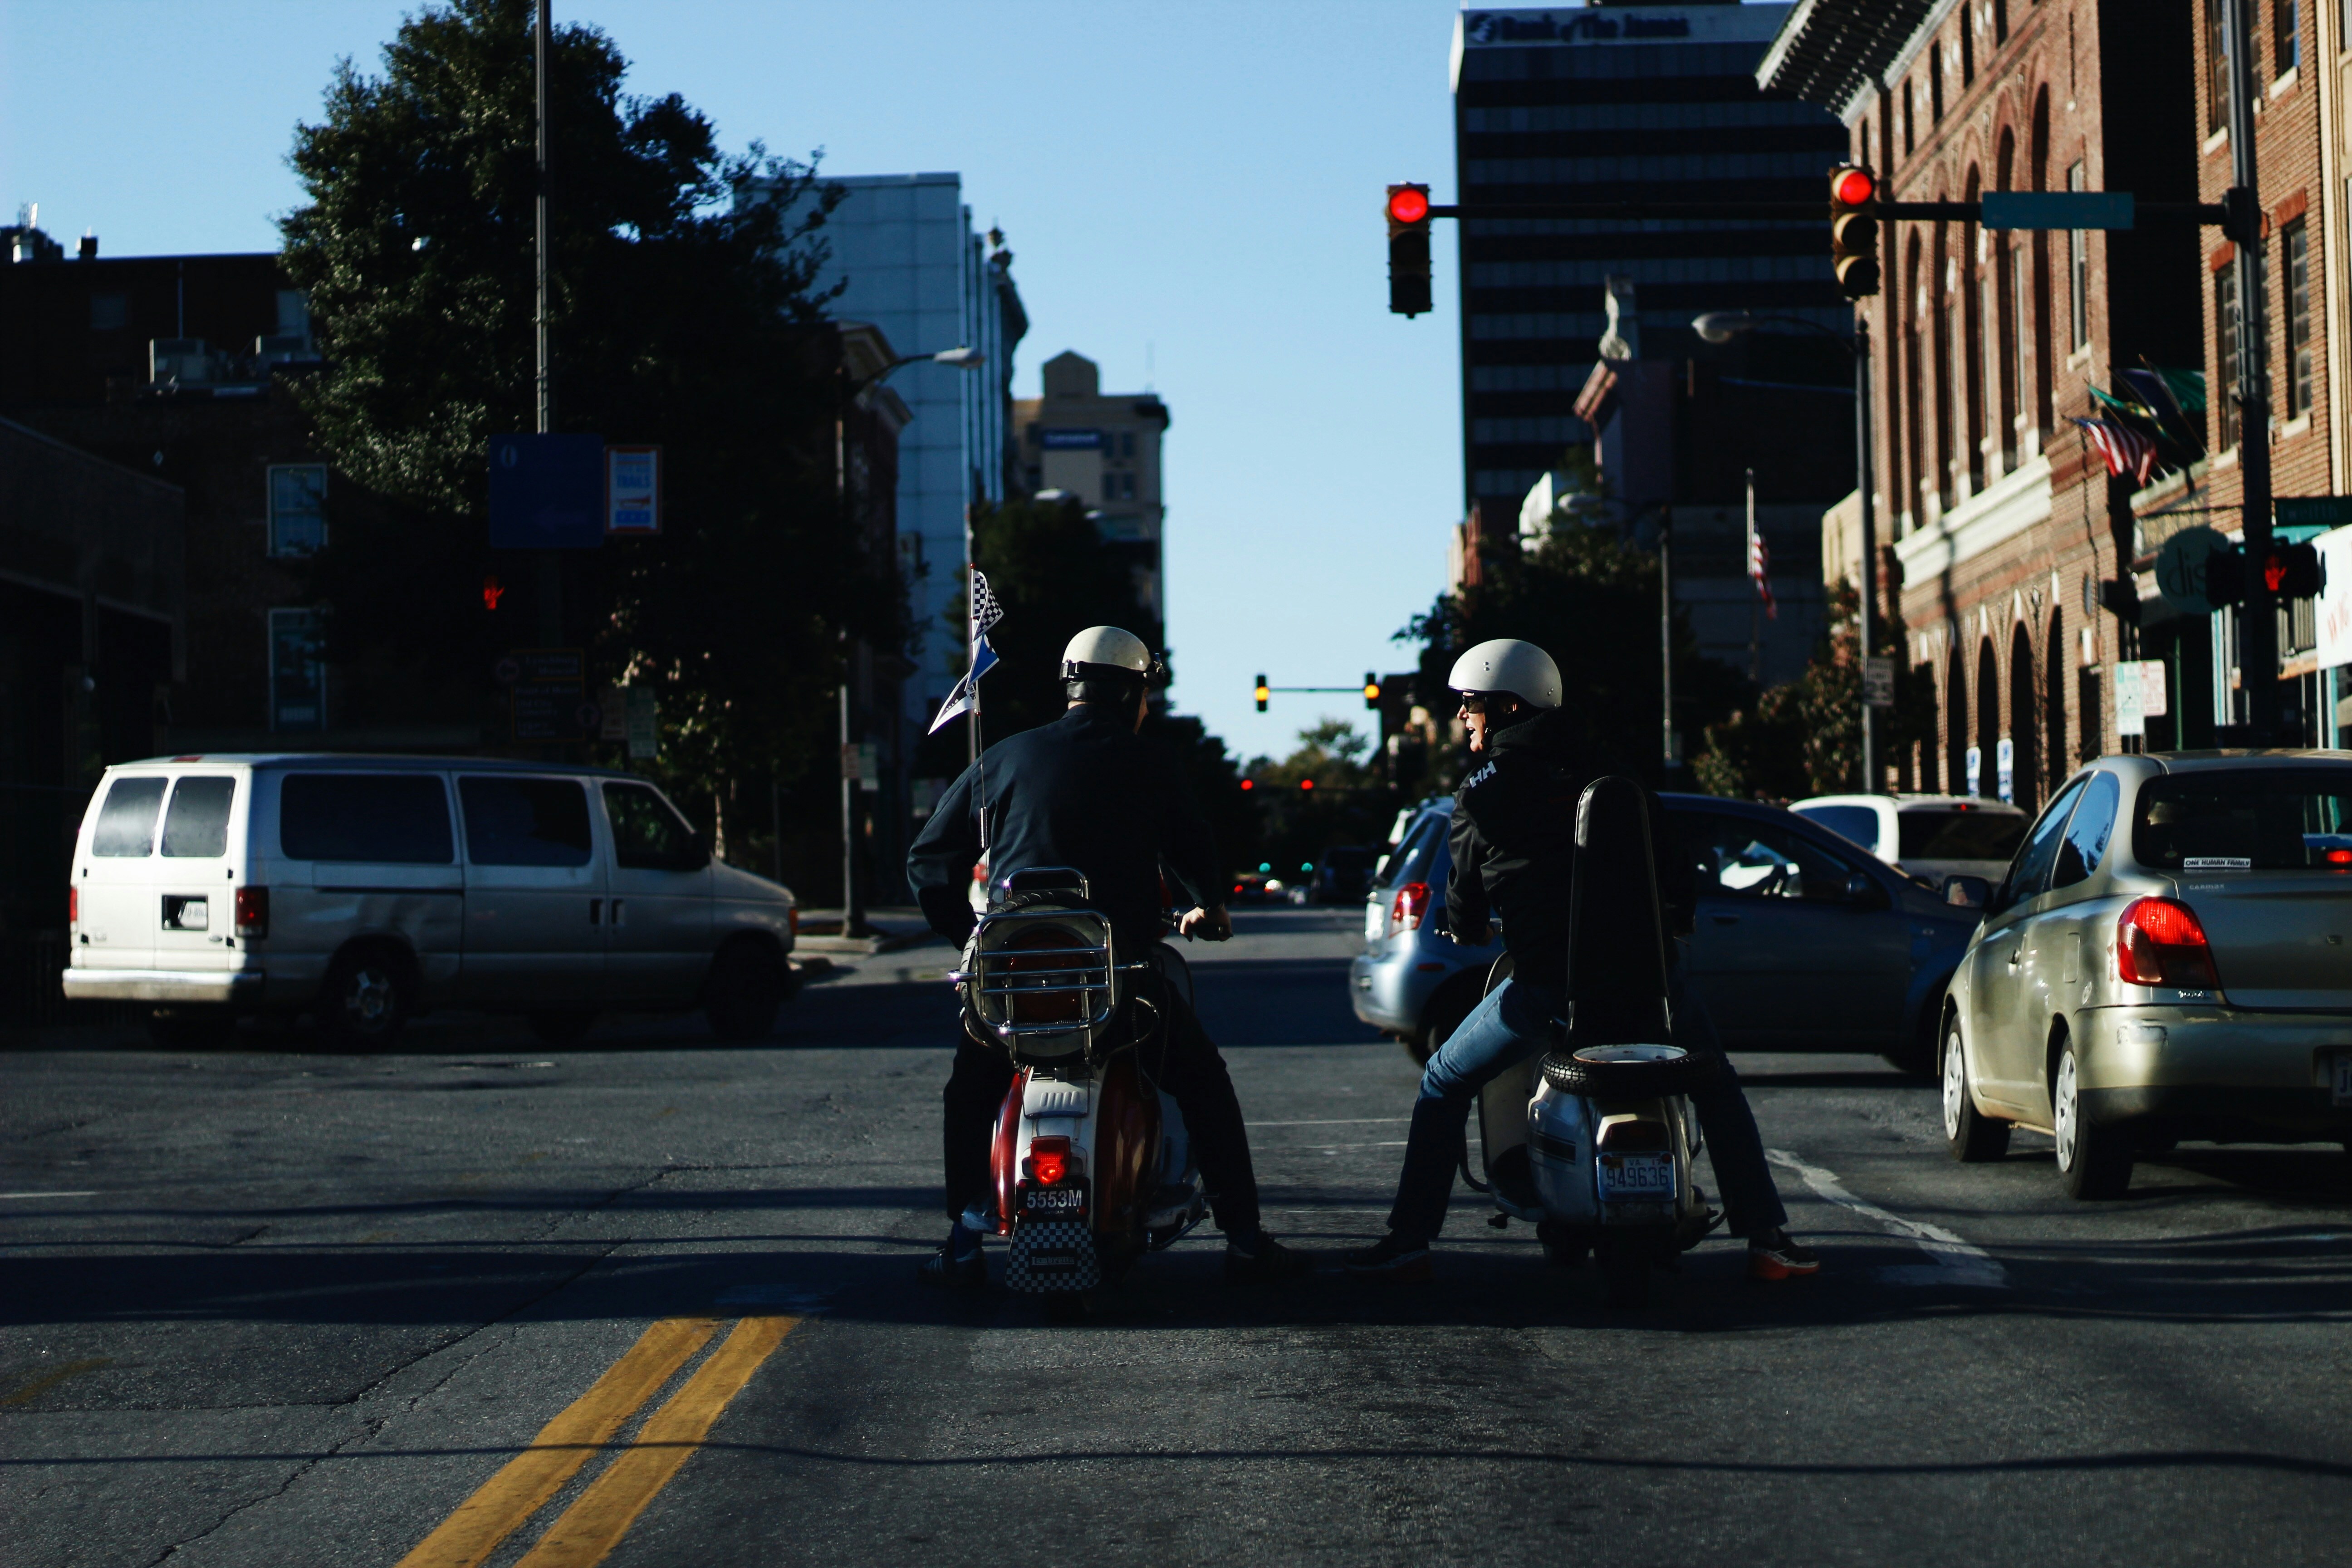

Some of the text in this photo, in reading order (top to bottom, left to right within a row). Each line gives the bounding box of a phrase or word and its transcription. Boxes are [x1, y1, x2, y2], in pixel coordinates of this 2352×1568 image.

[2166, 542, 2213, 596] dis
[1606, 1166, 1669, 1187] 949636
[1026, 1189, 1082, 1209] 5553M
[1031, 1256, 1075, 1265] Lambretta
